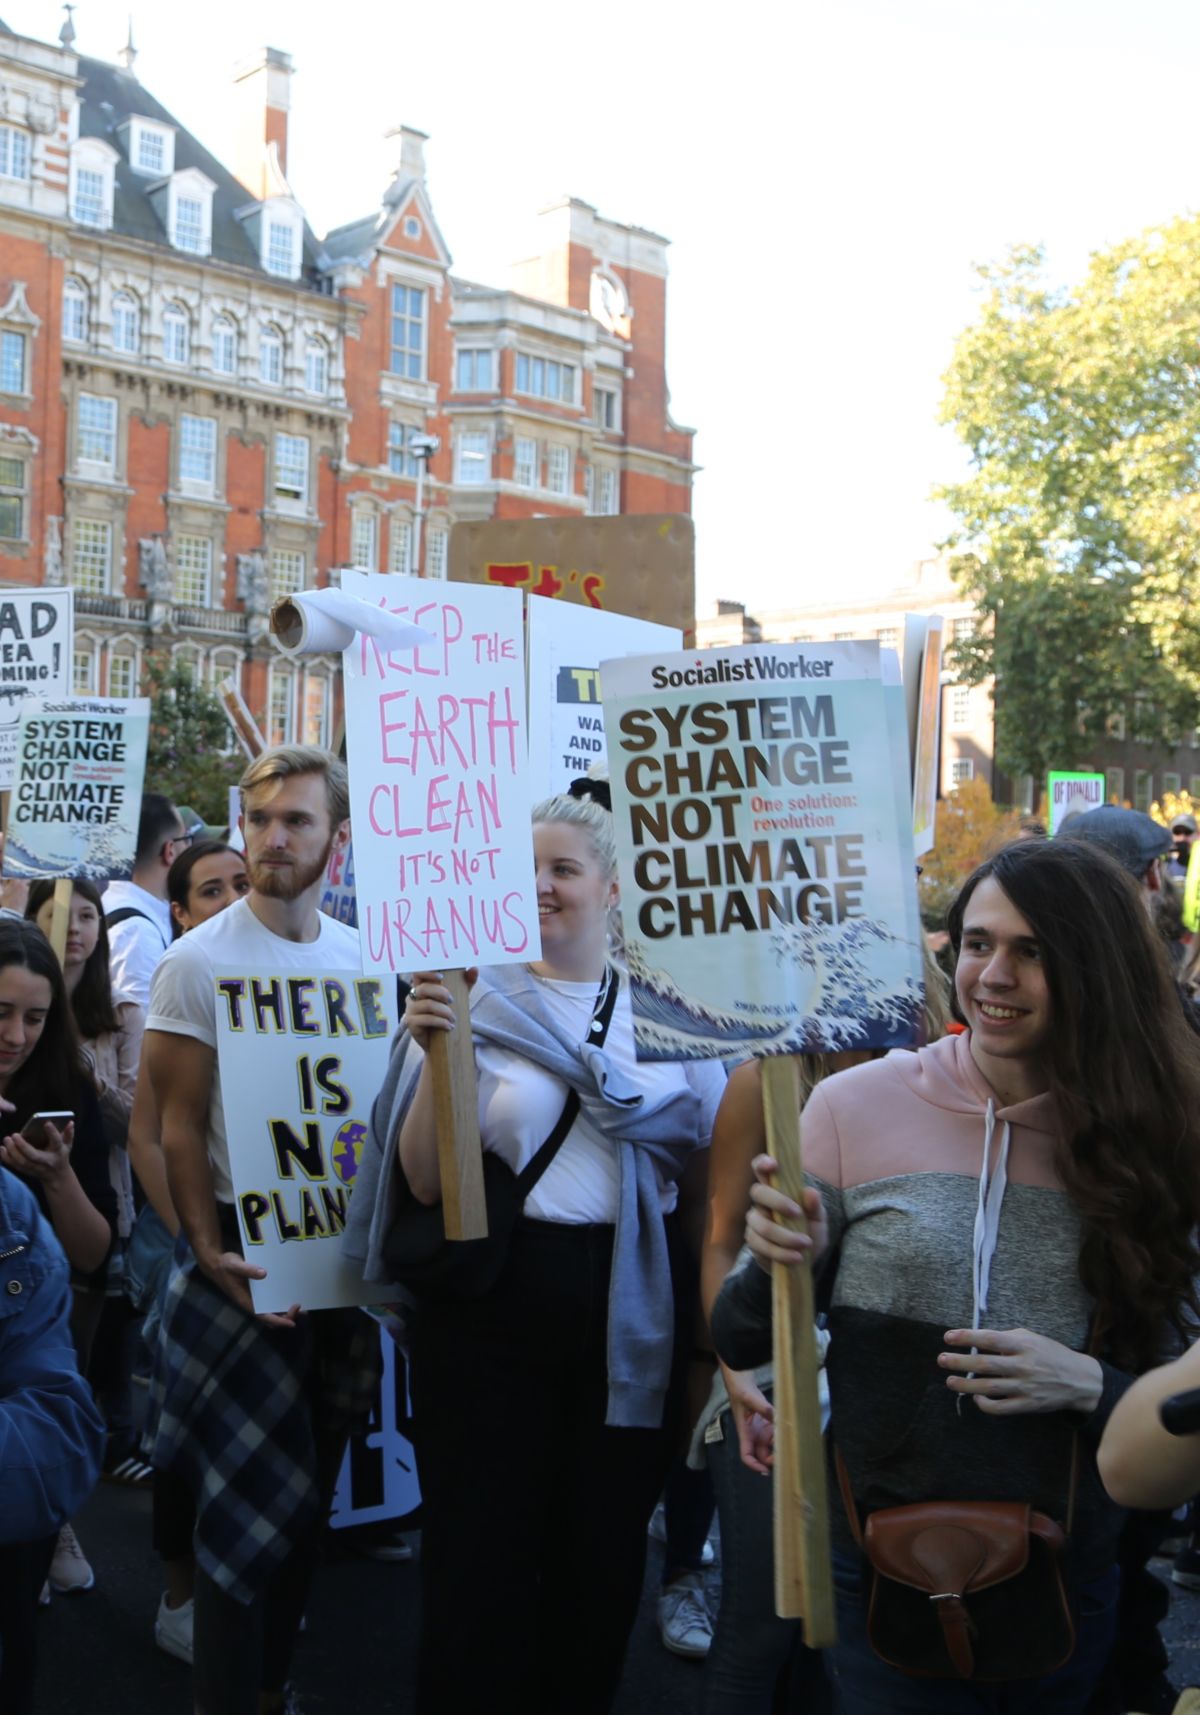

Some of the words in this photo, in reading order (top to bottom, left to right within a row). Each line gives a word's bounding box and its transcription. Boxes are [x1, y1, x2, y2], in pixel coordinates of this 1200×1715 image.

[361, 597, 463, 679] KEEP
[471, 632, 518, 664] THE
[652, 657, 754, 688] Socialist
[755, 654, 834, 680] Worker
[24, 720, 123, 741] SYSTEM
[42, 702, 86, 713] Socialist
[88, 702, 127, 714] Worker
[619, 695, 837, 752] SYSTEM
[23, 741, 127, 762] CHANGE
[379, 687, 520, 776] EARTH
[569, 735, 603, 753] AND
[20, 762, 69, 781] NOT
[624, 741, 853, 797] CHANGE
[15, 803, 120, 824] CHANGE
[18, 782, 125, 804] CLIMATE
[368, 774, 502, 844] CLEAN
[751, 796, 783, 813] One
[788, 793, 858, 811] solution:
[1054, 781, 1064, 804] OF
[1067, 781, 1101, 803] DONALD
[629, 795, 742, 846] NOT
[754, 812, 835, 831] revolution
[400, 850, 446, 892] IT'S
[634, 834, 867, 891] CLIMATE
[367, 892, 528, 971] URANUS
[638, 882, 865, 939] CHANGE
[215, 976, 390, 1039] THERE
[297, 1053, 352, 1117] IS
[239, 1184, 353, 1245] PLAN
